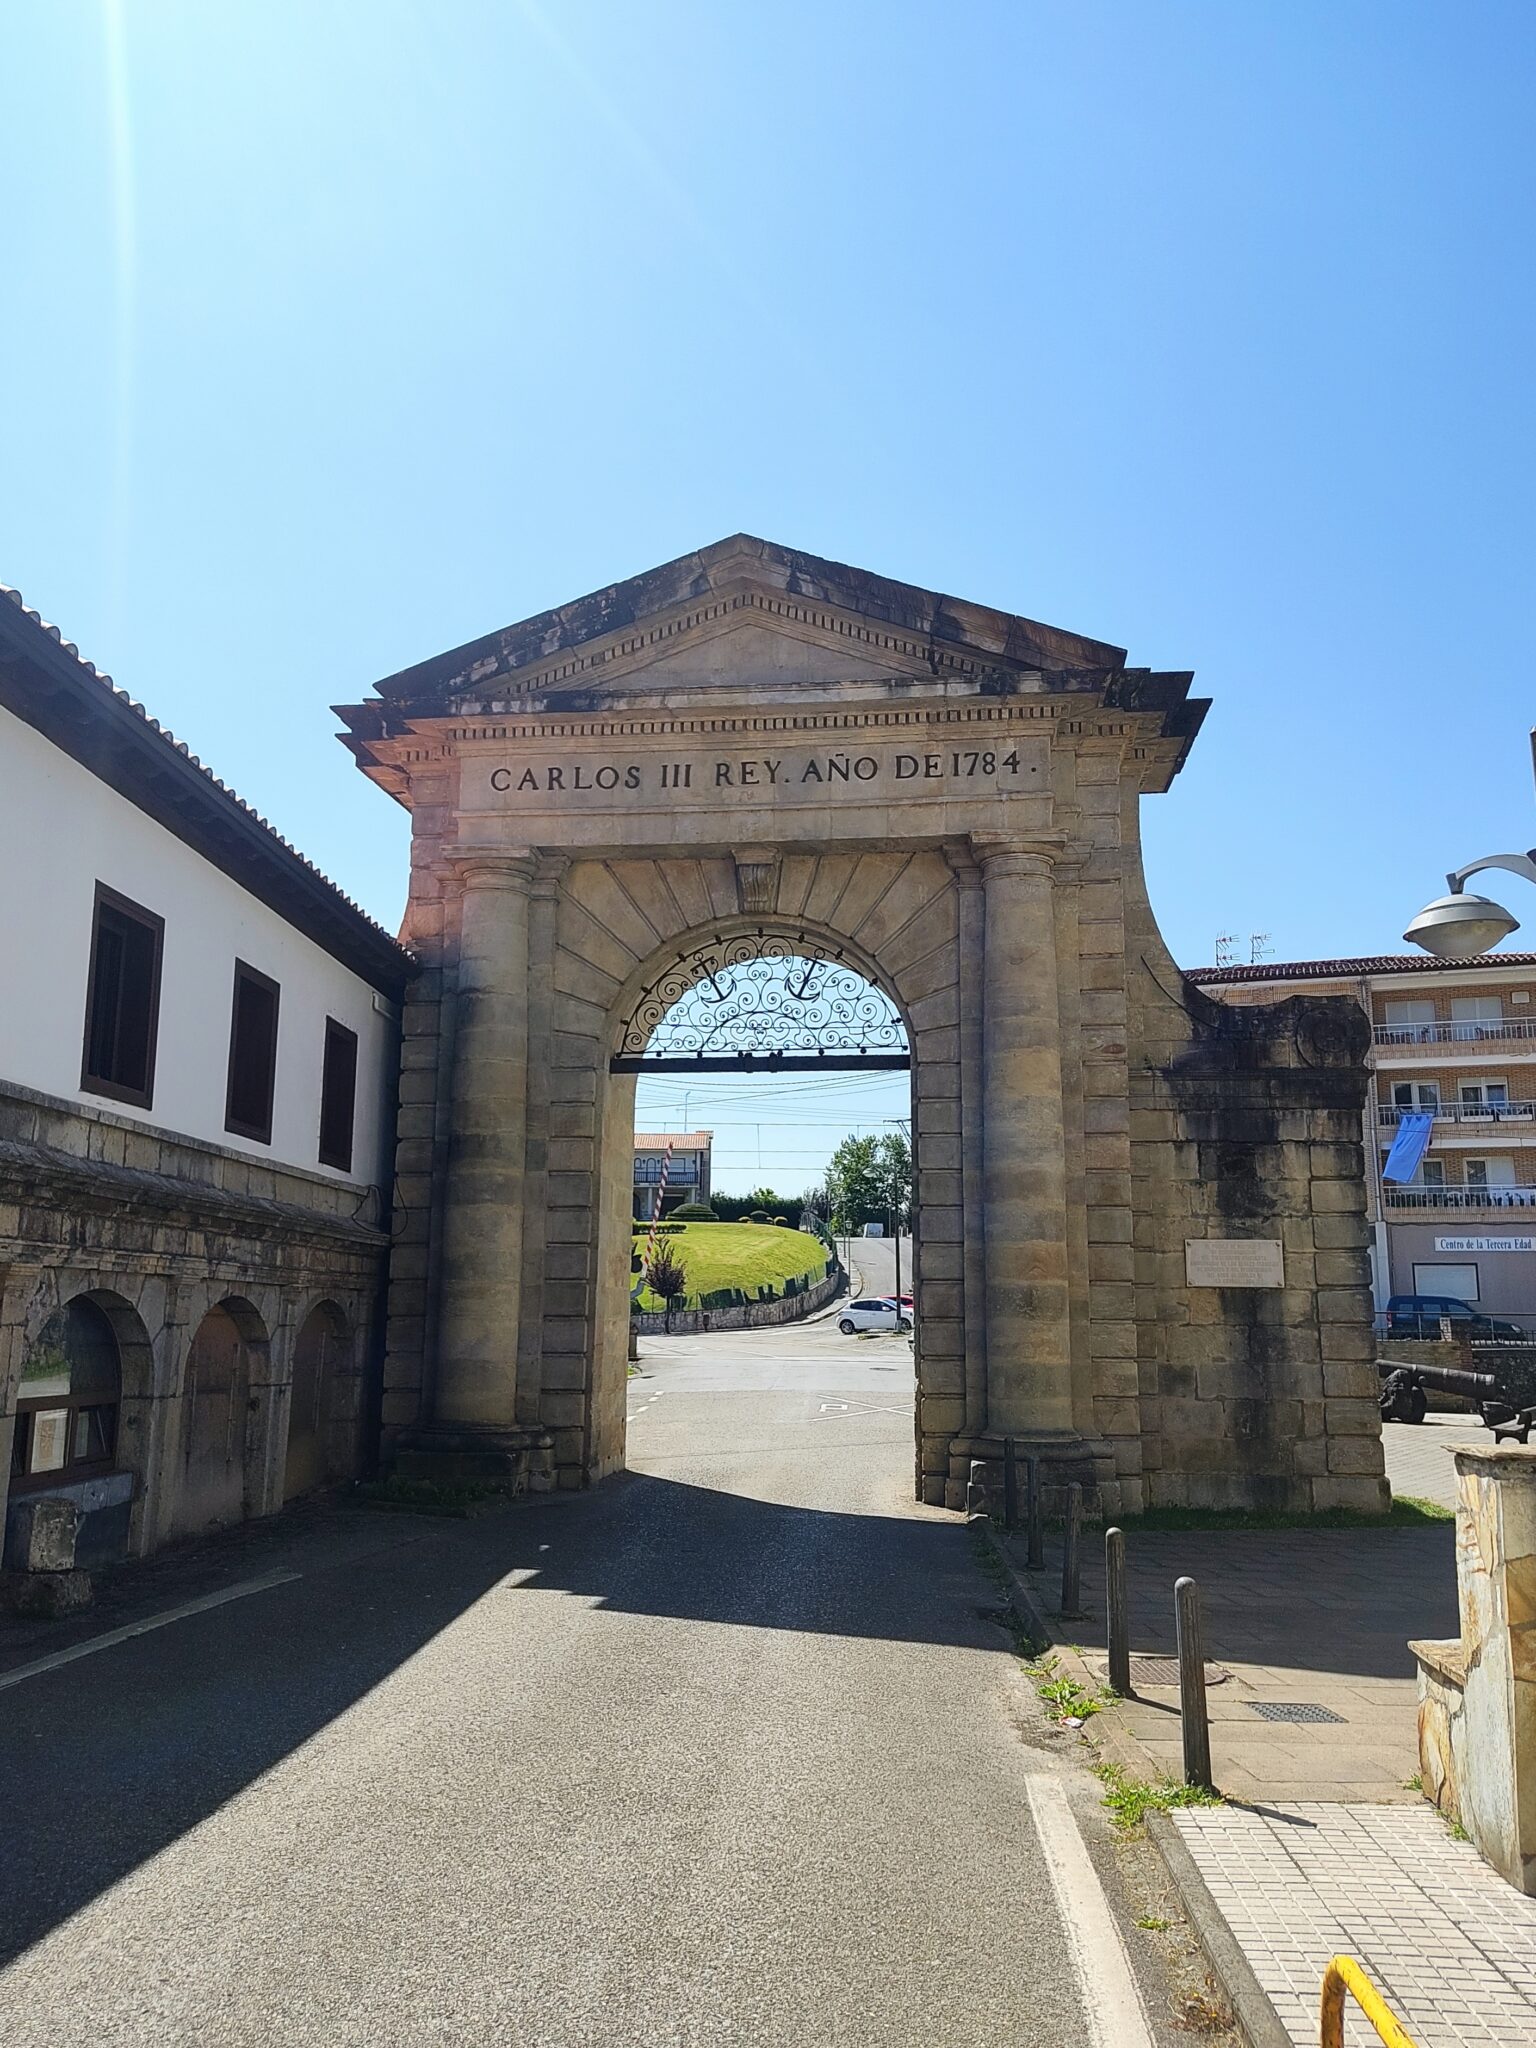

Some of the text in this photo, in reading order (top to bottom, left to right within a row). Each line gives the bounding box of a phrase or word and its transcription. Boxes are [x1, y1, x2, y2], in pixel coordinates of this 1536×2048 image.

[490, 765, 641, 793] CARLOS
[661, 764, 692, 789] III
[715, 760, 790, 787] REY.
[802, 752, 879, 782] AÑO
[1440, 1238, 1531, 1249] Centro de la Tercera Edad
